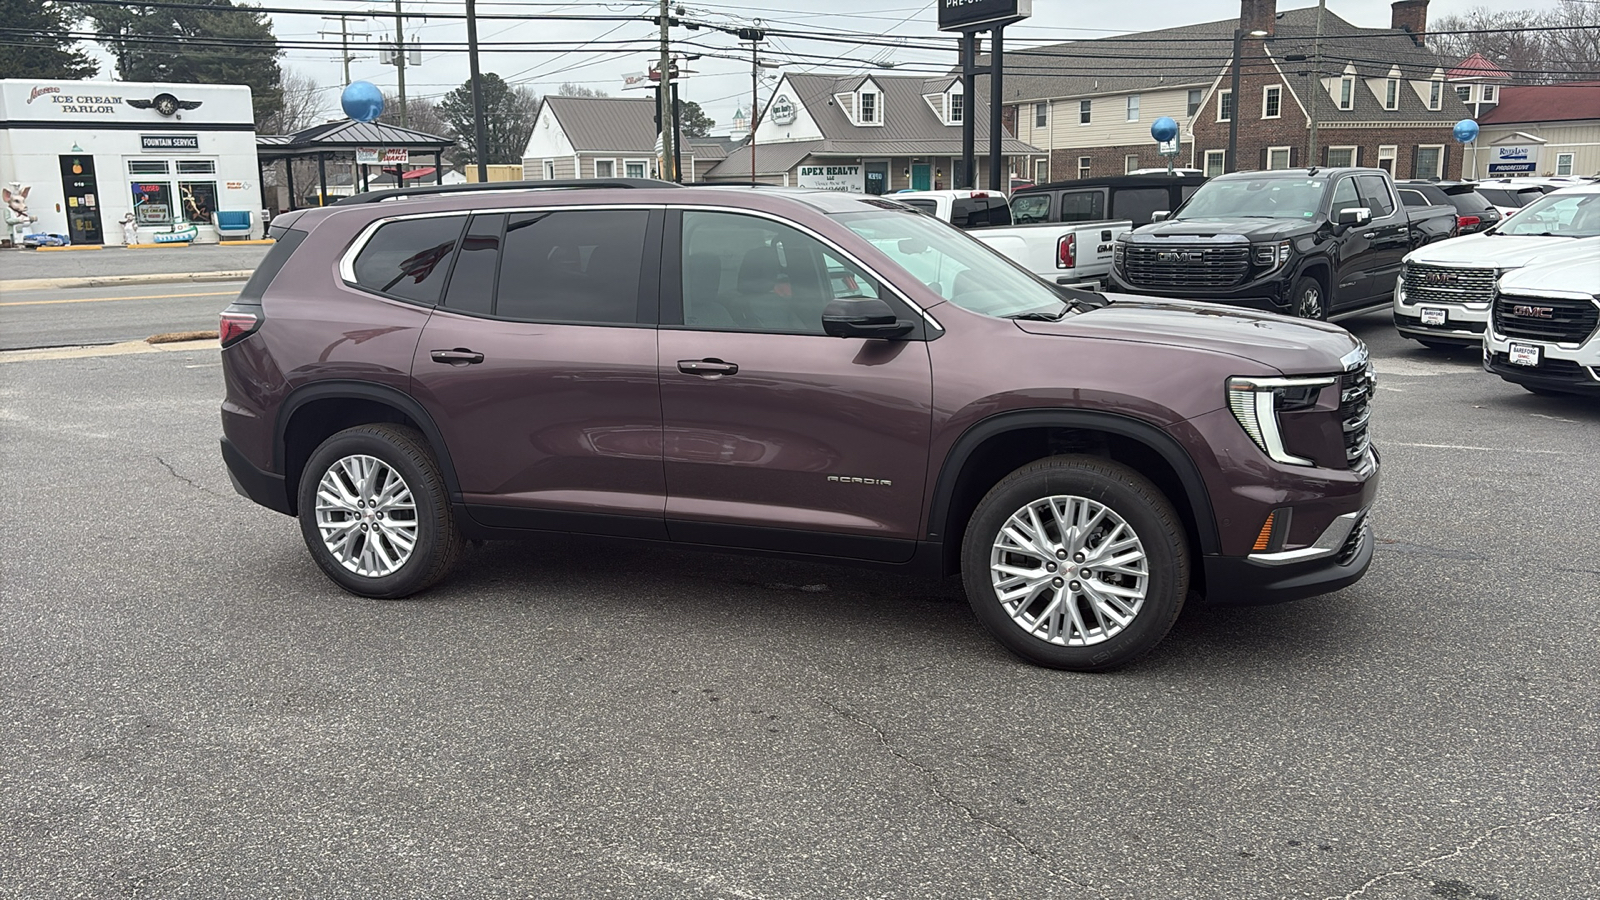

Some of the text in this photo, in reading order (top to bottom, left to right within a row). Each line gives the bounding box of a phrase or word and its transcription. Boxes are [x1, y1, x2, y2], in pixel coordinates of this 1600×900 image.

[76, 96, 123, 104] CREAM
[62, 105, 115, 113] PARLOR
[143, 138, 197, 146] FOUNTAIN SERVICE
[801, 166, 859, 176] APEX REALTY
[1097, 244, 1113, 253] GM
[1158, 252, 1202, 262] GMC
[1426, 272, 1458, 284] GMC
[1513, 305, 1553, 318] GMC
[1513, 347, 1537, 355] BAREFORD
[827, 475, 892, 486] ACADIA
